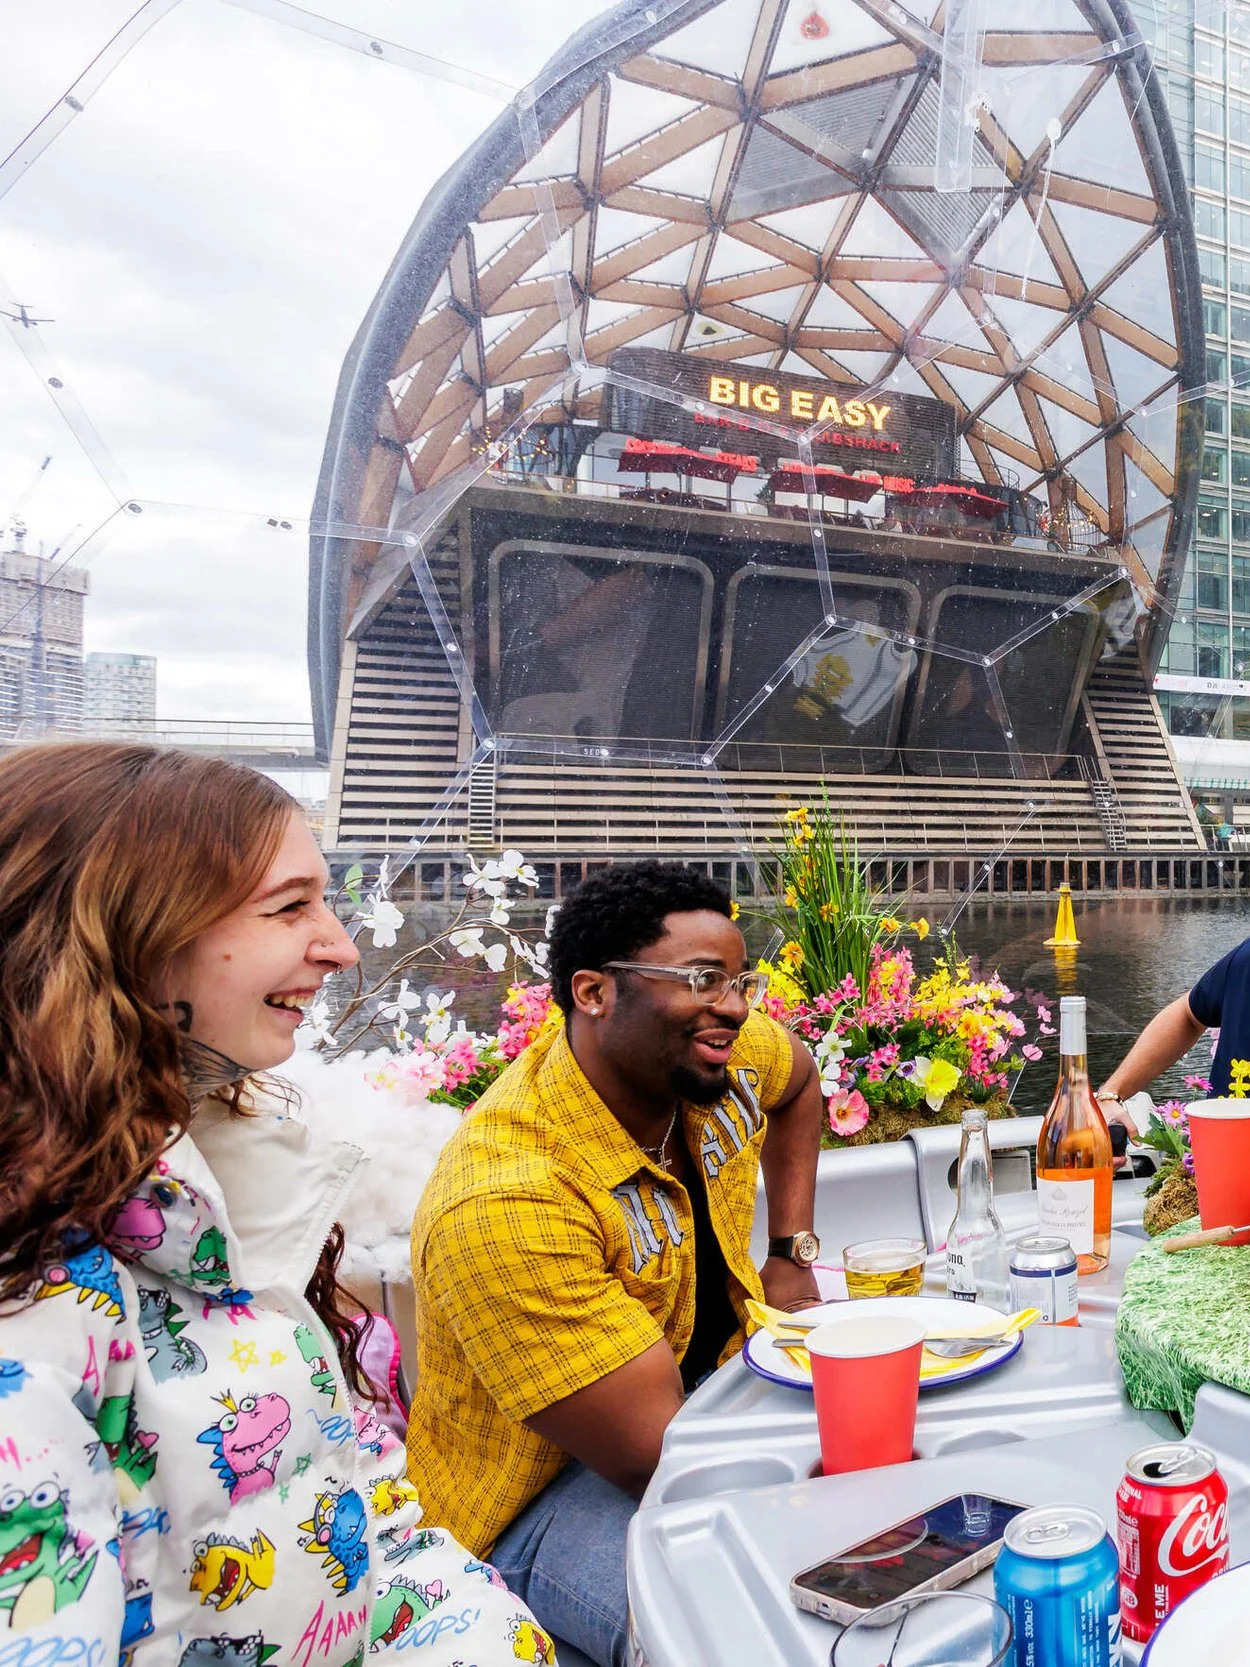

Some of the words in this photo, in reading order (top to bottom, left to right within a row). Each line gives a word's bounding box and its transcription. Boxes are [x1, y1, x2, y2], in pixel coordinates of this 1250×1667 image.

[709, 376, 780, 412] BIG
[790, 390, 891, 430] EASY
[1154, 1583, 1165, 1605] ME
[291, 1600, 366, 1667] AAAAH
[386, 1608, 481, 1651] OOPS!
